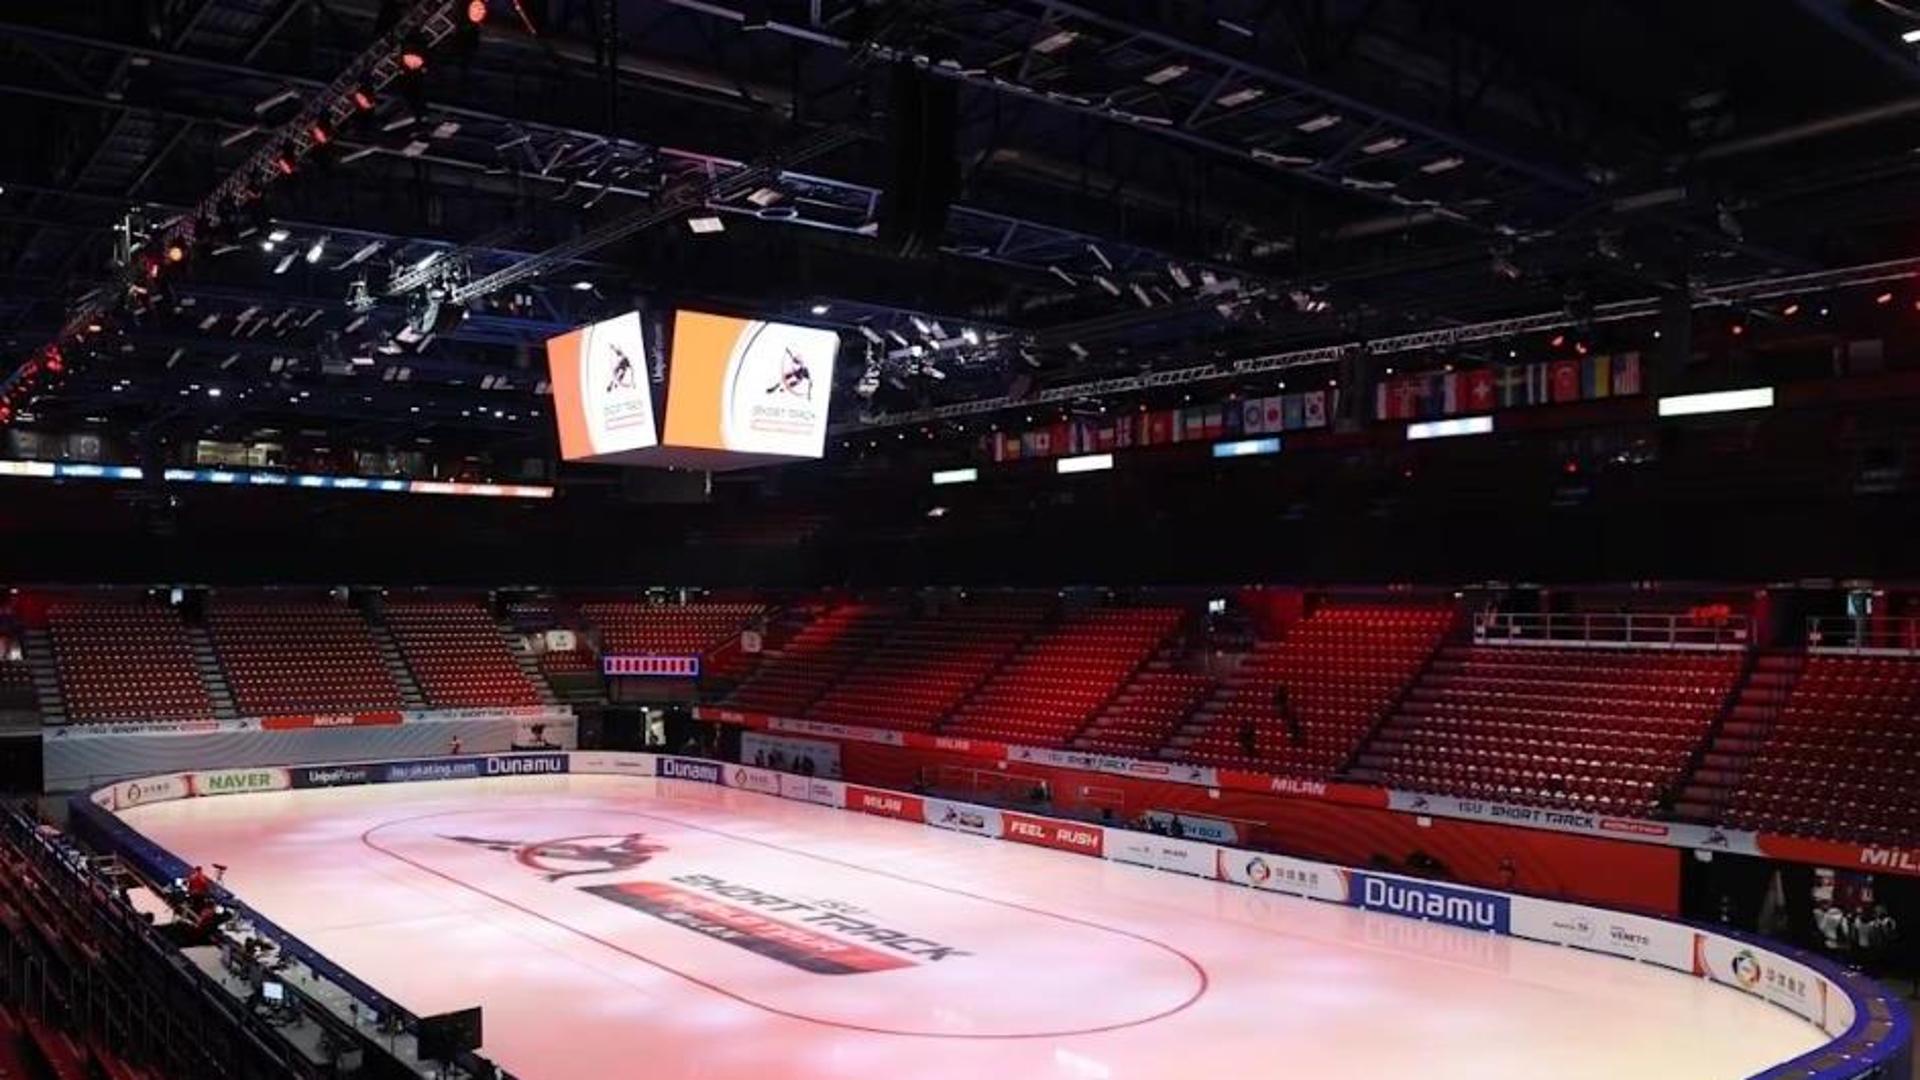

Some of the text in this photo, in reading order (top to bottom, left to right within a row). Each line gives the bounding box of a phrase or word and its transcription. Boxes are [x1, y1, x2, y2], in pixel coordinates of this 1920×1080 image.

[313, 715, 354, 727] MILAN
[487, 757, 561, 774] Dunamu
[662, 759, 718, 782] Dunamu
[209, 774, 270, 790] NAVER
[1271, 777, 1327, 796] MILAN
[863, 795, 901, 812] MILAN
[1459, 801, 1482, 815] ISU
[1490, 805, 1539, 823] SHORT
[1545, 812, 1594, 829] TRACK
[1011, 820, 1099, 848] FEEL RUSH
[1860, 848, 1920, 870] MIL
[1365, 877, 1496, 927] Dunamu
[670, 873, 978, 962] SHORT TRACK
